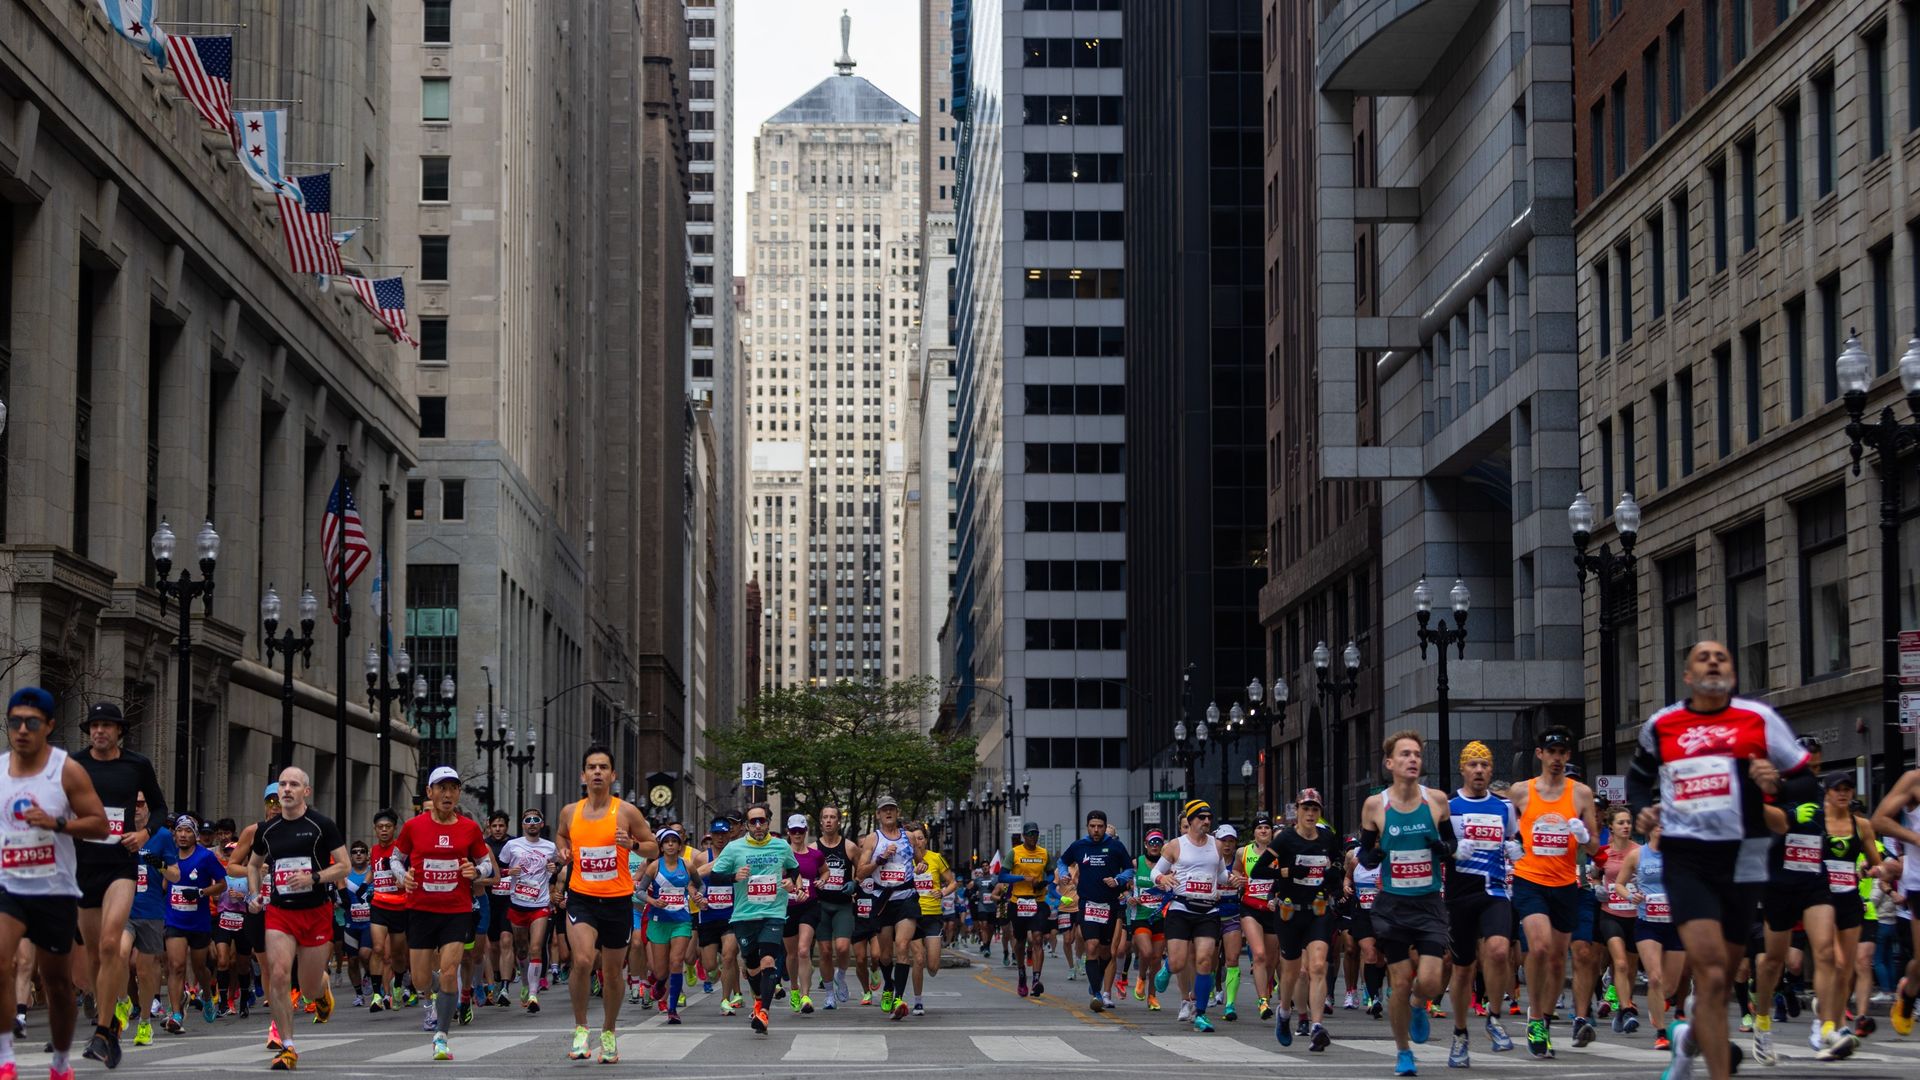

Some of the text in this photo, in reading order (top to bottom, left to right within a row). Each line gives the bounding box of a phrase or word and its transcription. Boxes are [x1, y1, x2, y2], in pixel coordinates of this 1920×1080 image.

[746, 771, 762, 779] 3:20
[1685, 776, 1728, 793] 22857
[1402, 823, 1427, 832] GLASA
[1465, 826, 1501, 838] C 8578
[1533, 835, 1539, 843] C
[3, 847, 53, 863] C 23952
[1785, 847, 1794, 857] C
[581, 858, 616, 869] C 5476
[1392, 863, 1432, 874] C 23530
[275, 873, 281, 881] A
[432, 871, 458, 880] 12222
[516, 884, 539, 895] C 6506
[748, 884, 775, 893] B 1391
[171, 895, 177, 903] C
[1092, 908, 1109, 916] 3202
